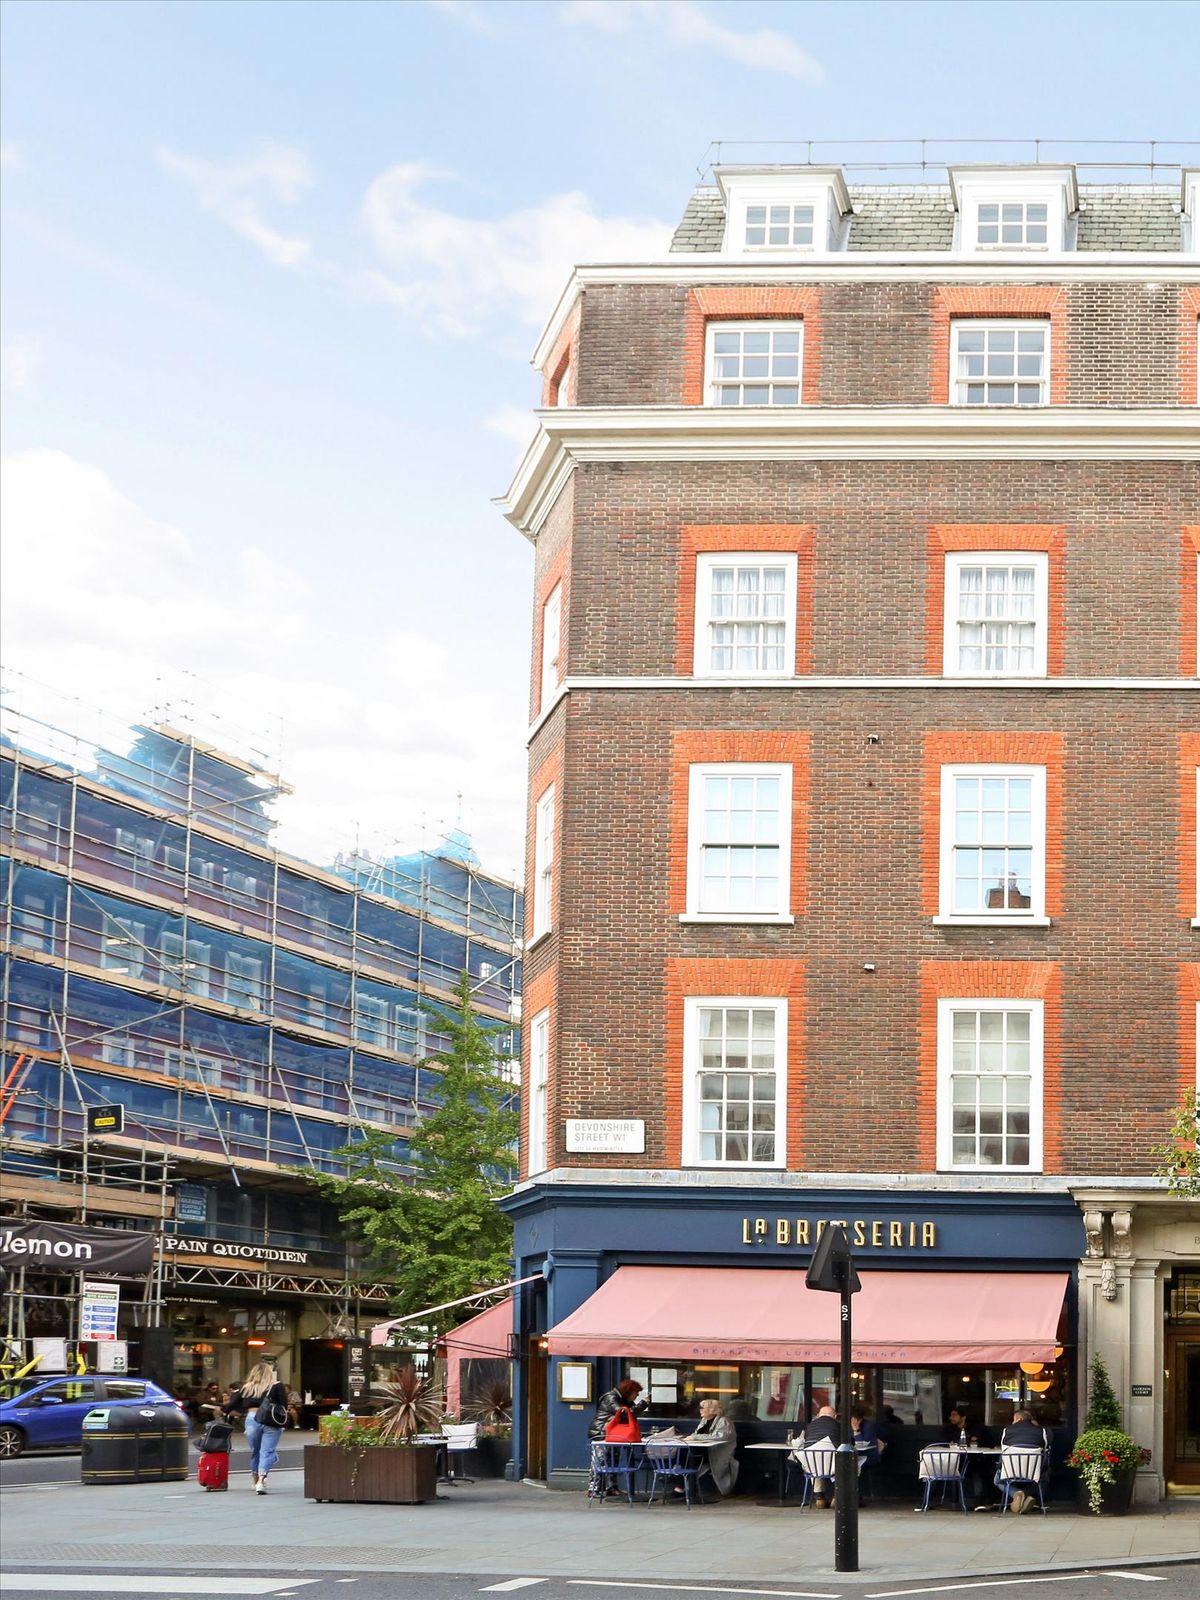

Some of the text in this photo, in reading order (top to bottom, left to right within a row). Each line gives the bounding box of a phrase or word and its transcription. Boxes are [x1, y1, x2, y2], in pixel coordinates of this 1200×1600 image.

[574, 1122, 636, 1132] DEVONSHIRE
[574, 1133, 626, 1141] STREET W1
[0, 1231, 92, 1259] lemon
[165, 1238, 208, 1253] PAIN
[213, 1243, 308, 1264] QUOTIDIEN
